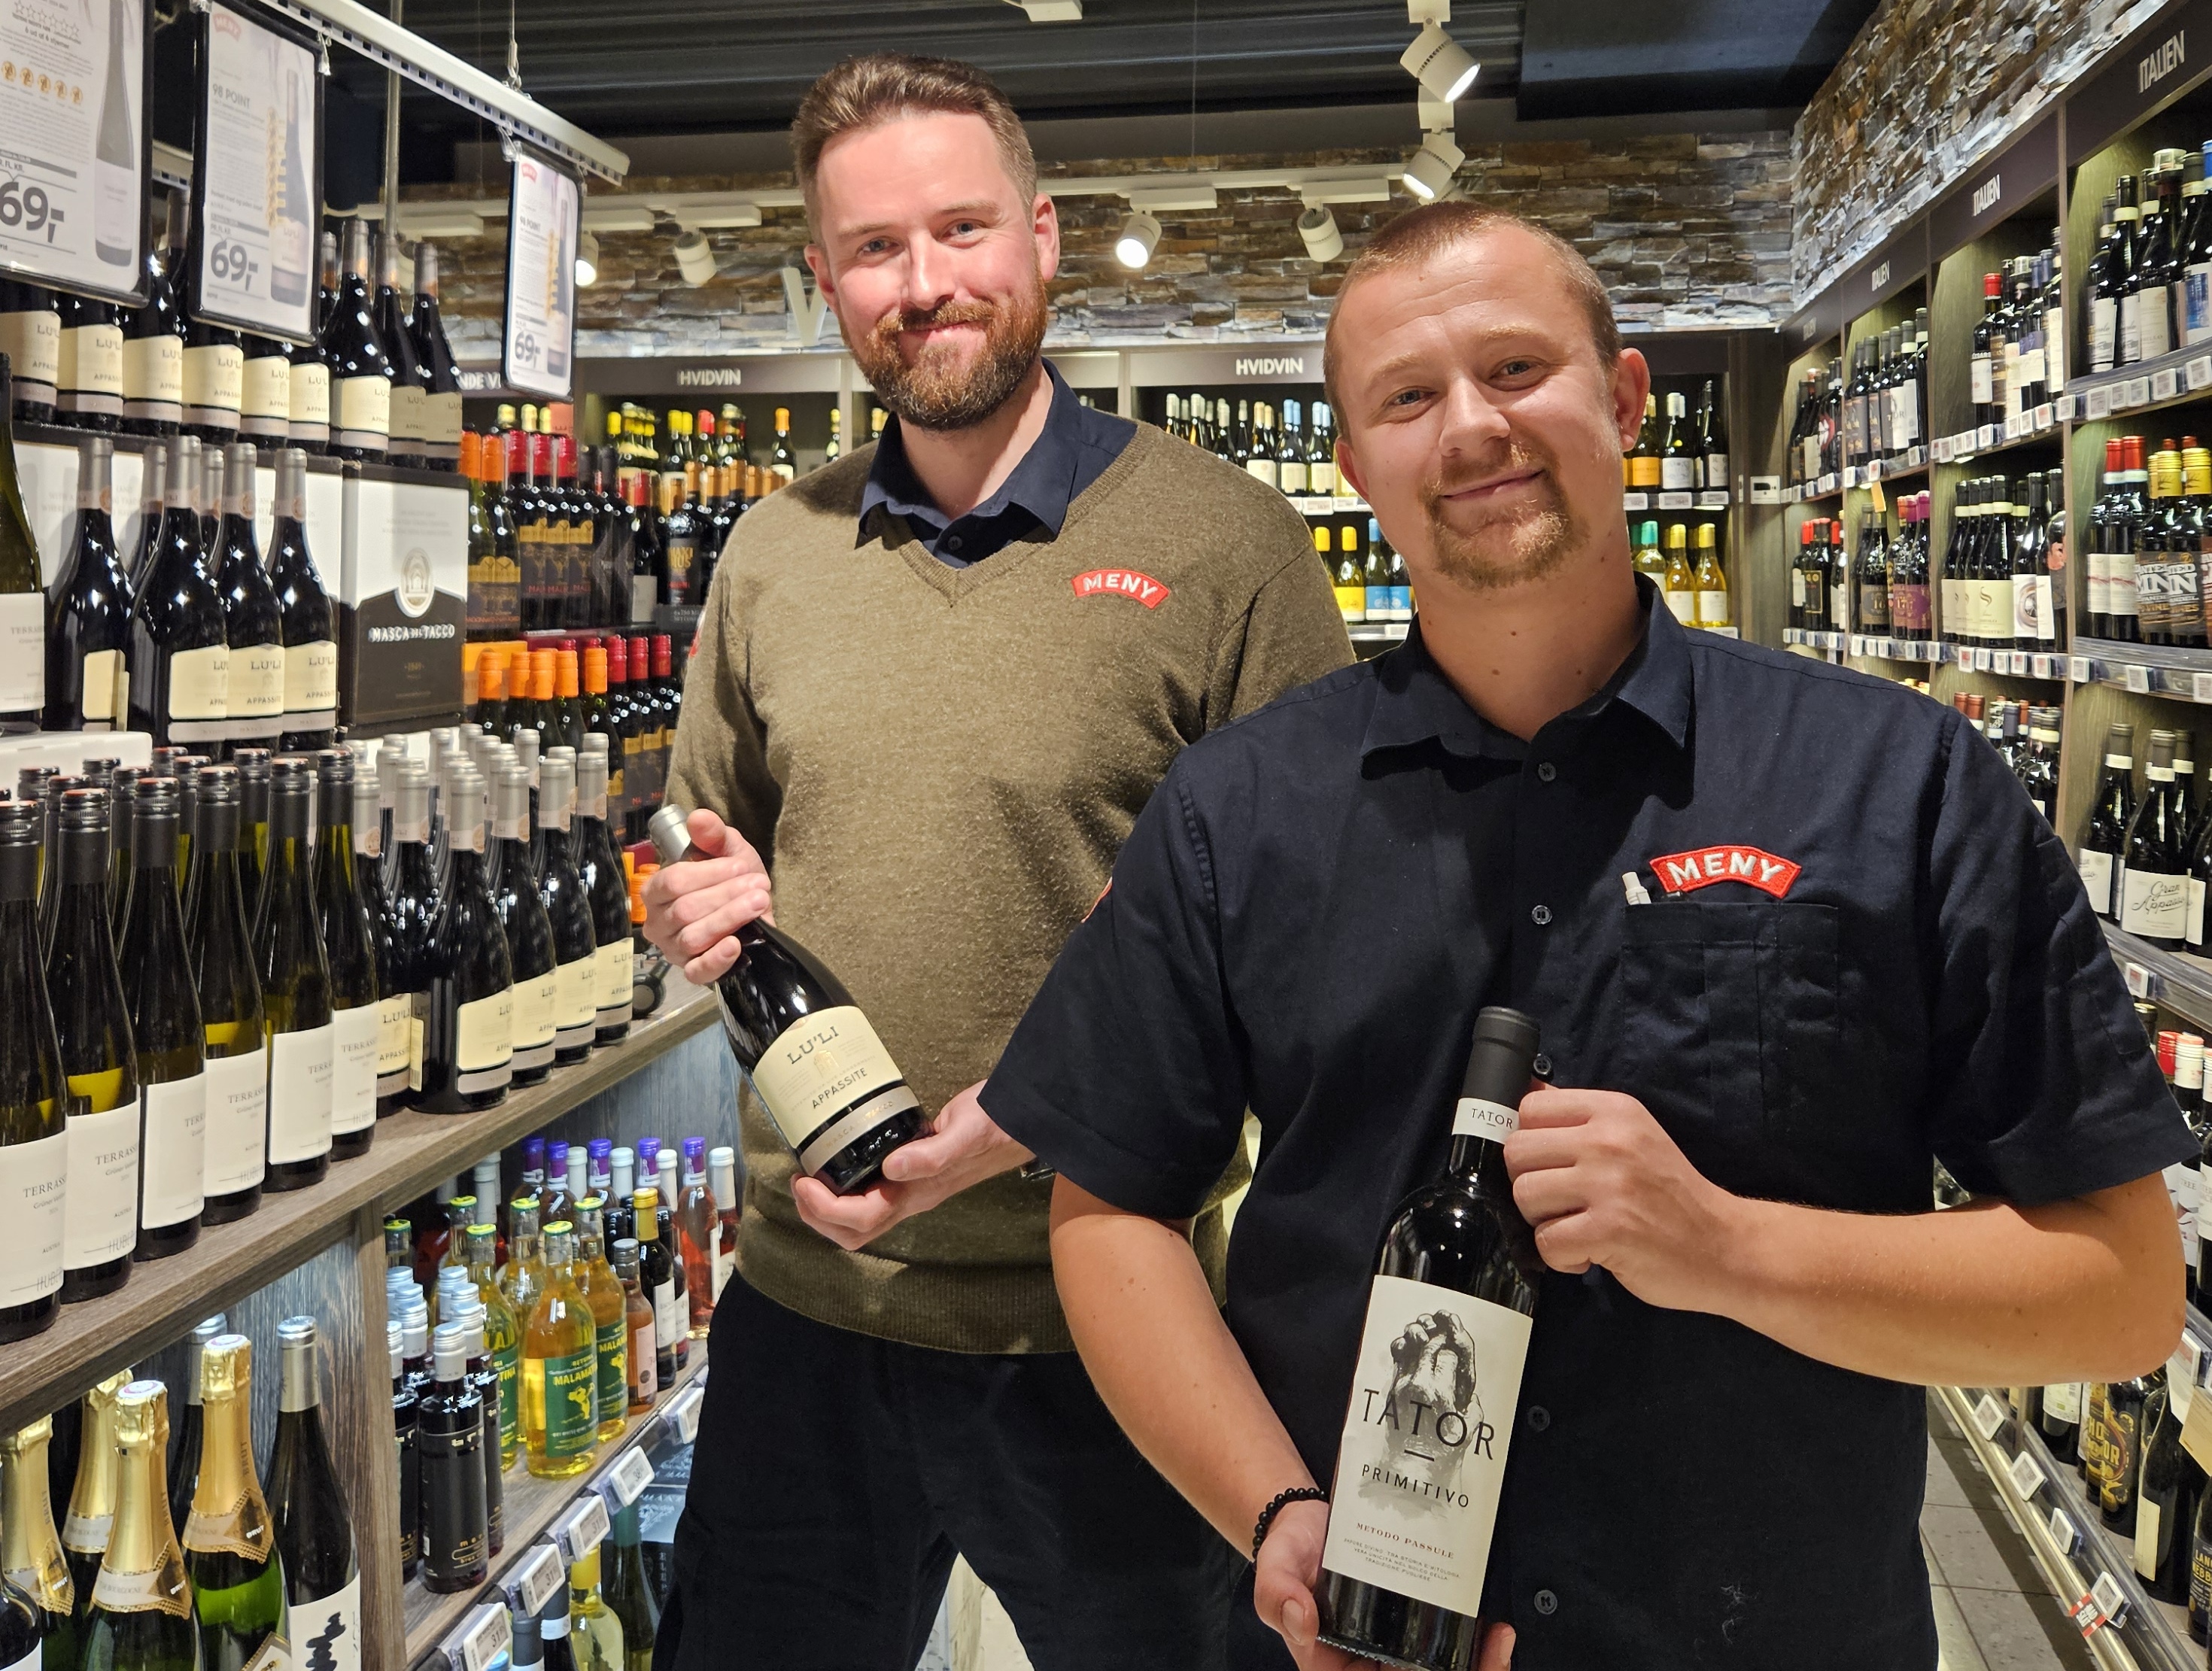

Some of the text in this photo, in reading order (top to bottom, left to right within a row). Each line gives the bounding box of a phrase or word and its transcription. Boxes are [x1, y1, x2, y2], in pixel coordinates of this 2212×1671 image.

[2140, 29, 2185, 93] ITALIEN
[212, 84, 251, 108] 98 POINT
[1973, 174, 2001, 217] ITALIEN
[679, 368, 741, 386] HVIDVIN
[1235, 357, 1304, 375] HVIDVIN
[458, 372, 501, 390] NDE VI
[1083, 573, 1159, 600] MENY
[371, 627, 409, 643] MASCA
[422, 624, 455, 640] TACCO
[251, 660, 281, 670] LU'LI
[1666, 851, 1785, 887] MENY
[787, 1025, 840, 1065] LU'LI
[812, 1068, 868, 1110] APPASSITE
[1472, 1107, 1513, 1129] TATOR
[1363, 1388, 1495, 1461] TATOR
[1361, 1463, 1469, 1508] PRIMITIVO
[1356, 1522, 1454, 1560] METODO PASSULE
[2195, 1549, 2212, 1568] LAN
